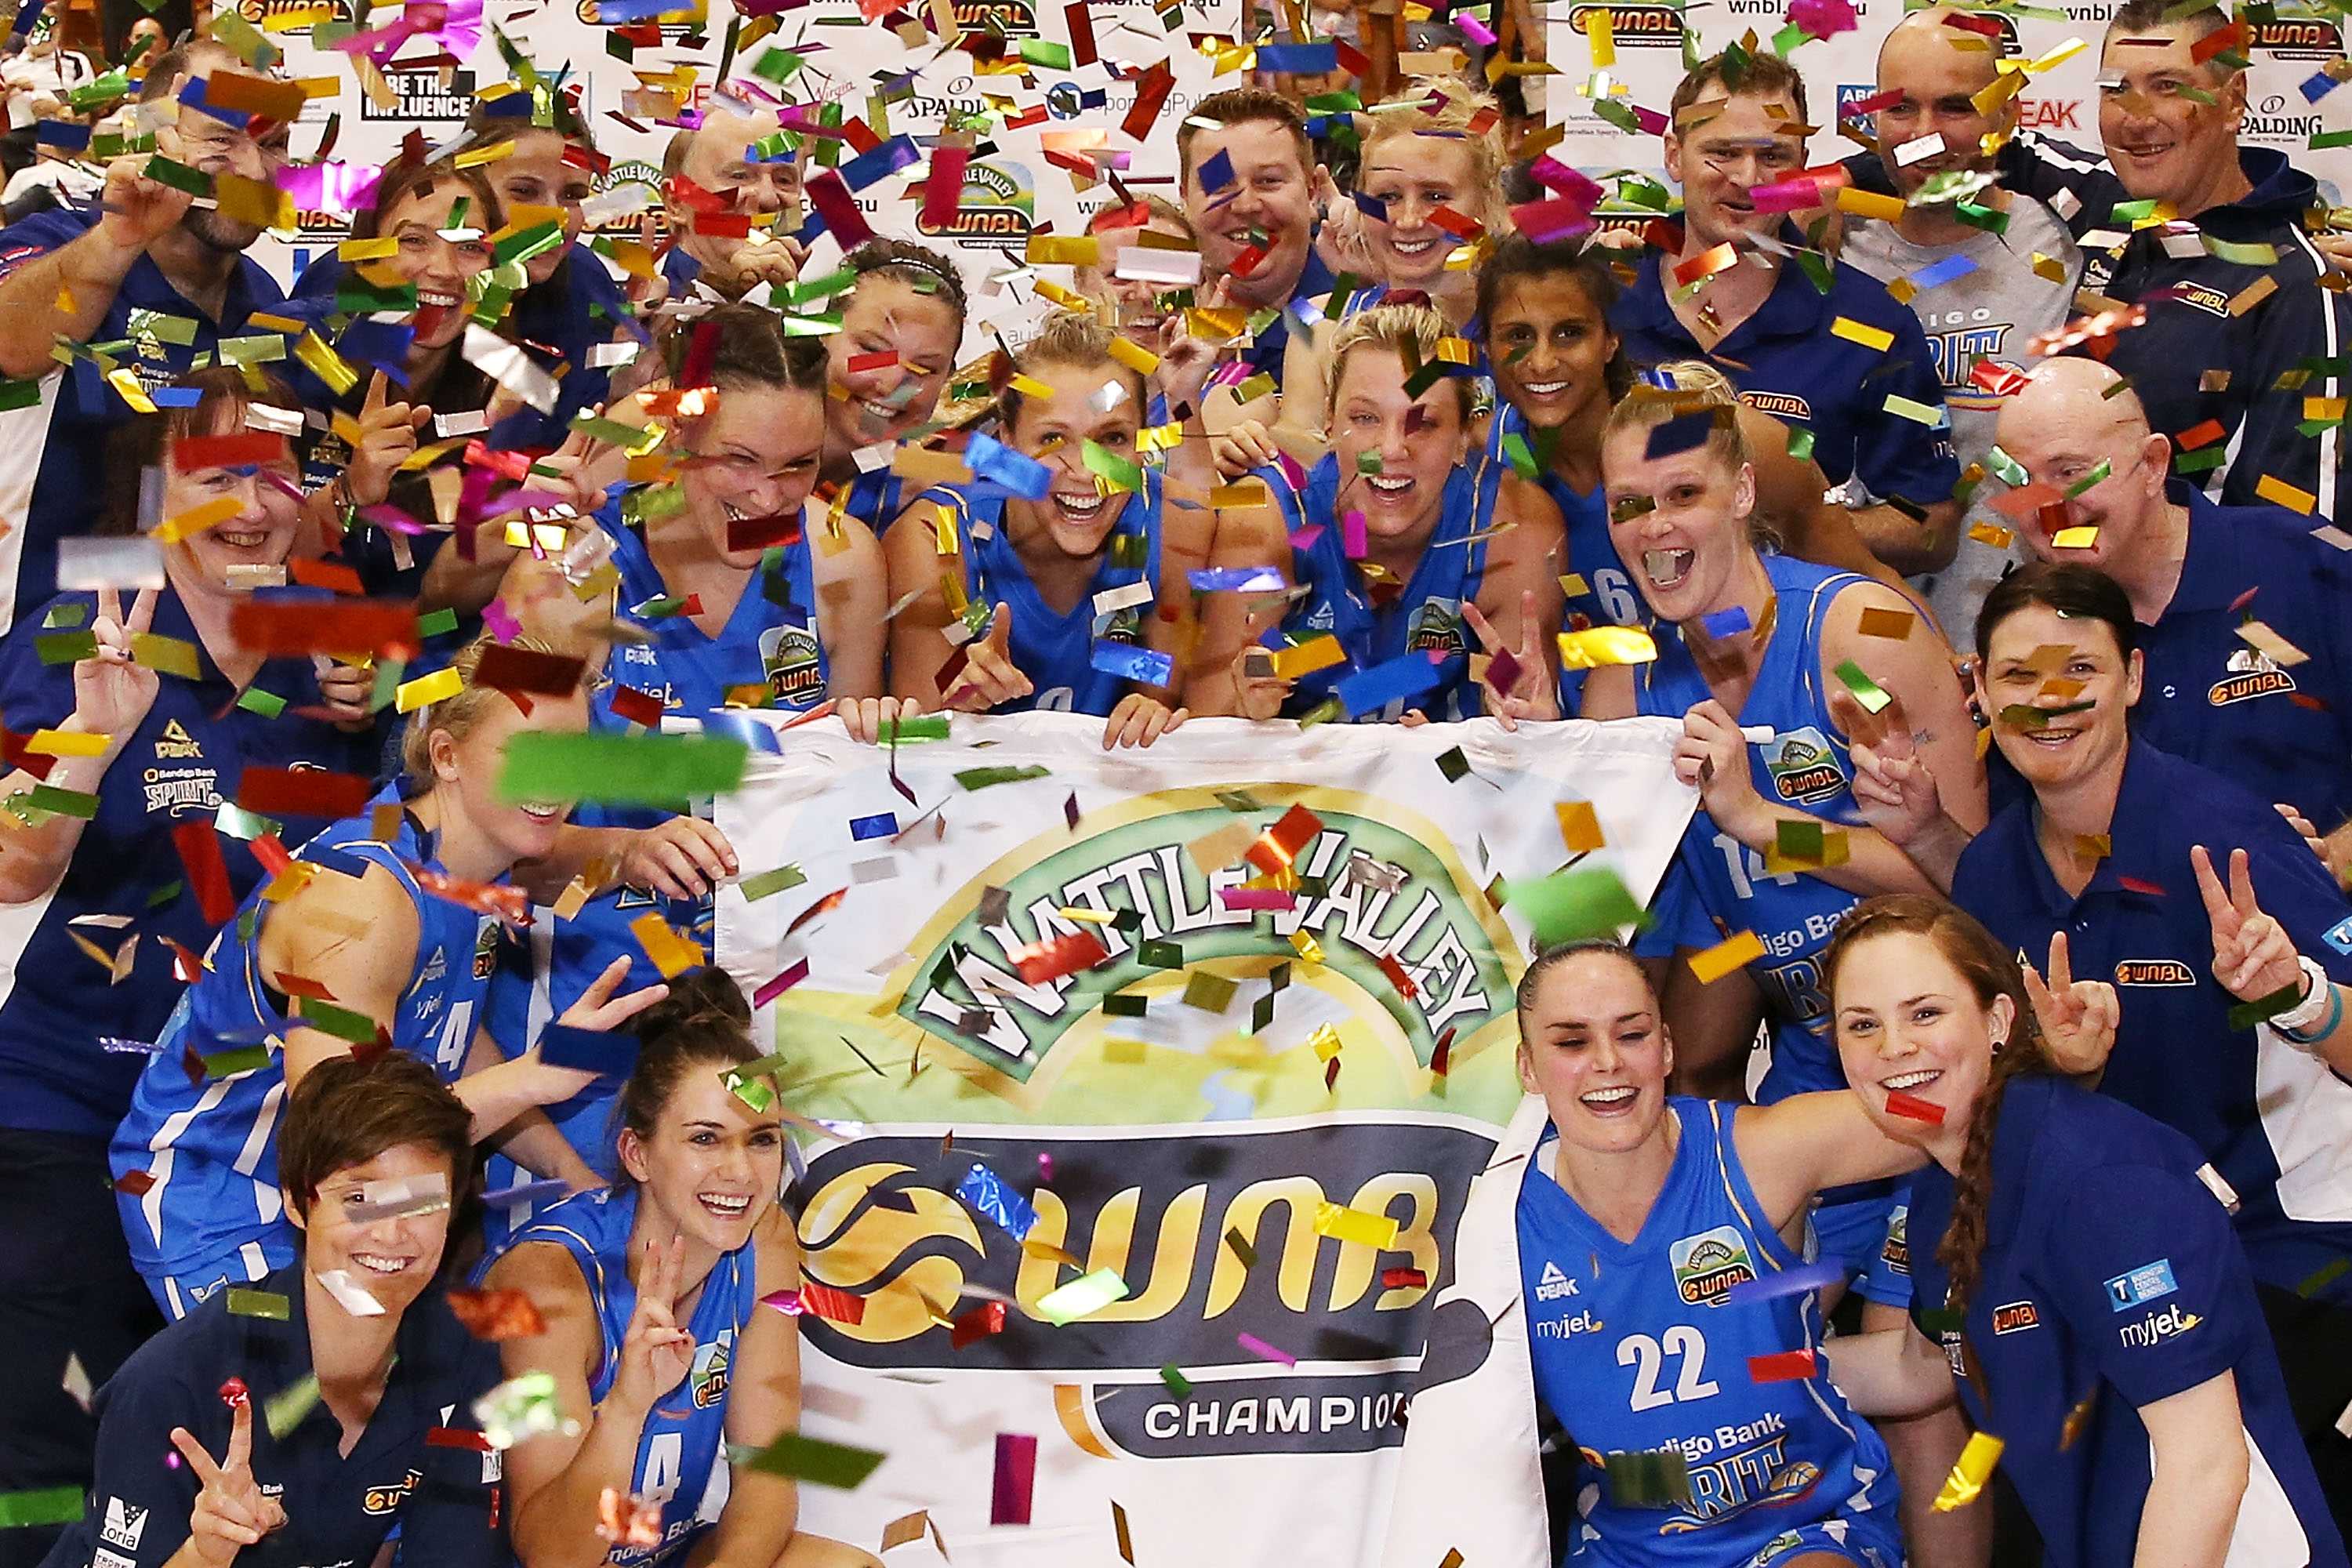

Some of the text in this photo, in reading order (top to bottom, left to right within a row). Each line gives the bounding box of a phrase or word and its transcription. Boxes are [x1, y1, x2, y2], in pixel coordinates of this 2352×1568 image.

[2018, 101, 2082, 128] EAK
[2241, 115, 2323, 136] PALDING
[2187, 290, 2226, 313] WNBL
[1756, 396, 1807, 416] WNBL
[1593, 568, 1638, 626] 6
[2230, 671, 2291, 698] WNBL
[1794, 770, 1838, 792] WNBL
[143, 778, 216, 813] SPIRIT
[918, 845, 1252, 1058] WATTLE
[2133, 965, 2190, 982] WNBL
[1014, 1173, 1438, 1323] WNB
[1534, 1279, 1581, 1302] PEAK
[1700, 1268, 1751, 1295] WNBL
[1536, 1309, 1592, 1339] myjet
[2120, 1303, 2183, 1348] myjet
[1616, 1325, 1720, 1413] 22
[1715, 1413, 1787, 1450] Bank
[641, 1432, 682, 1504] 4
